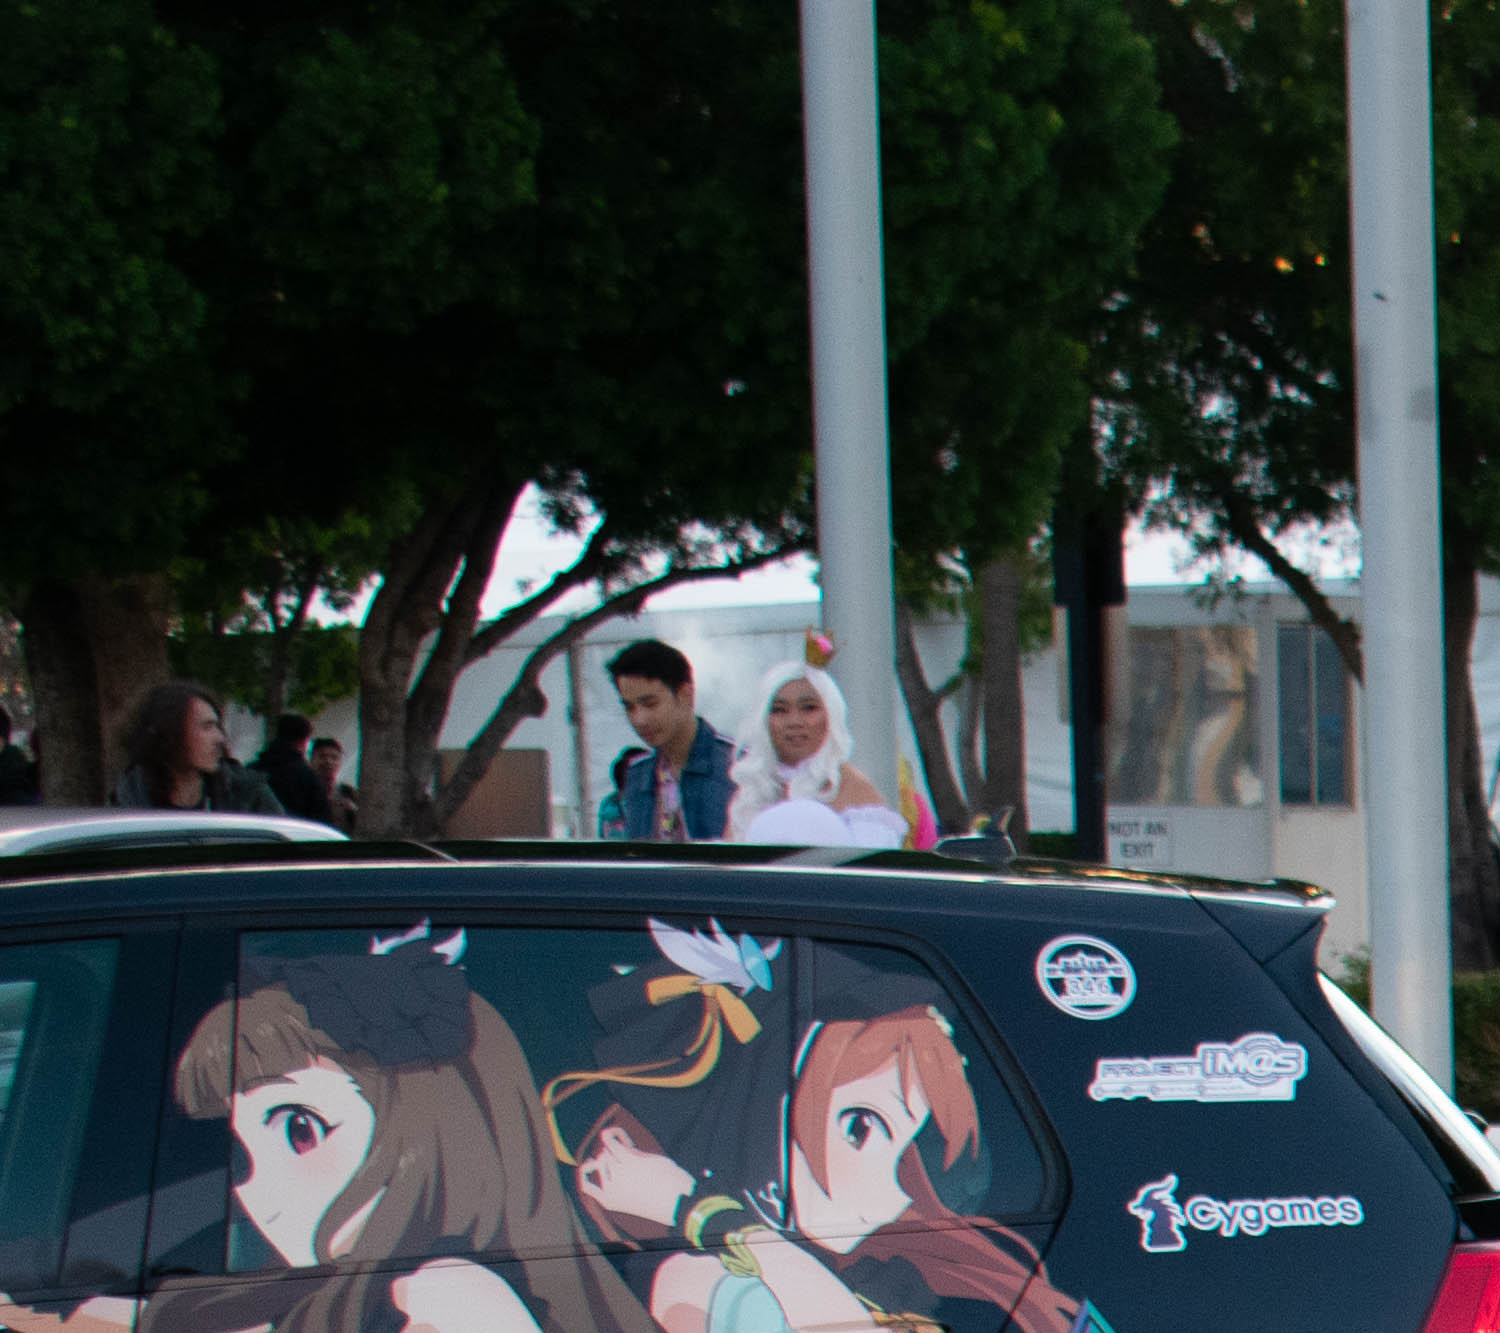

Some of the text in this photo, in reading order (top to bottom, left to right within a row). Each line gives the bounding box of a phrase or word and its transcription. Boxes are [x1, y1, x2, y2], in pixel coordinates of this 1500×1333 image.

[1109, 821, 1168, 836] NOT AN
[1120, 841, 1155, 858] EXIT
[1187, 1197, 1362, 1234] Cygames
